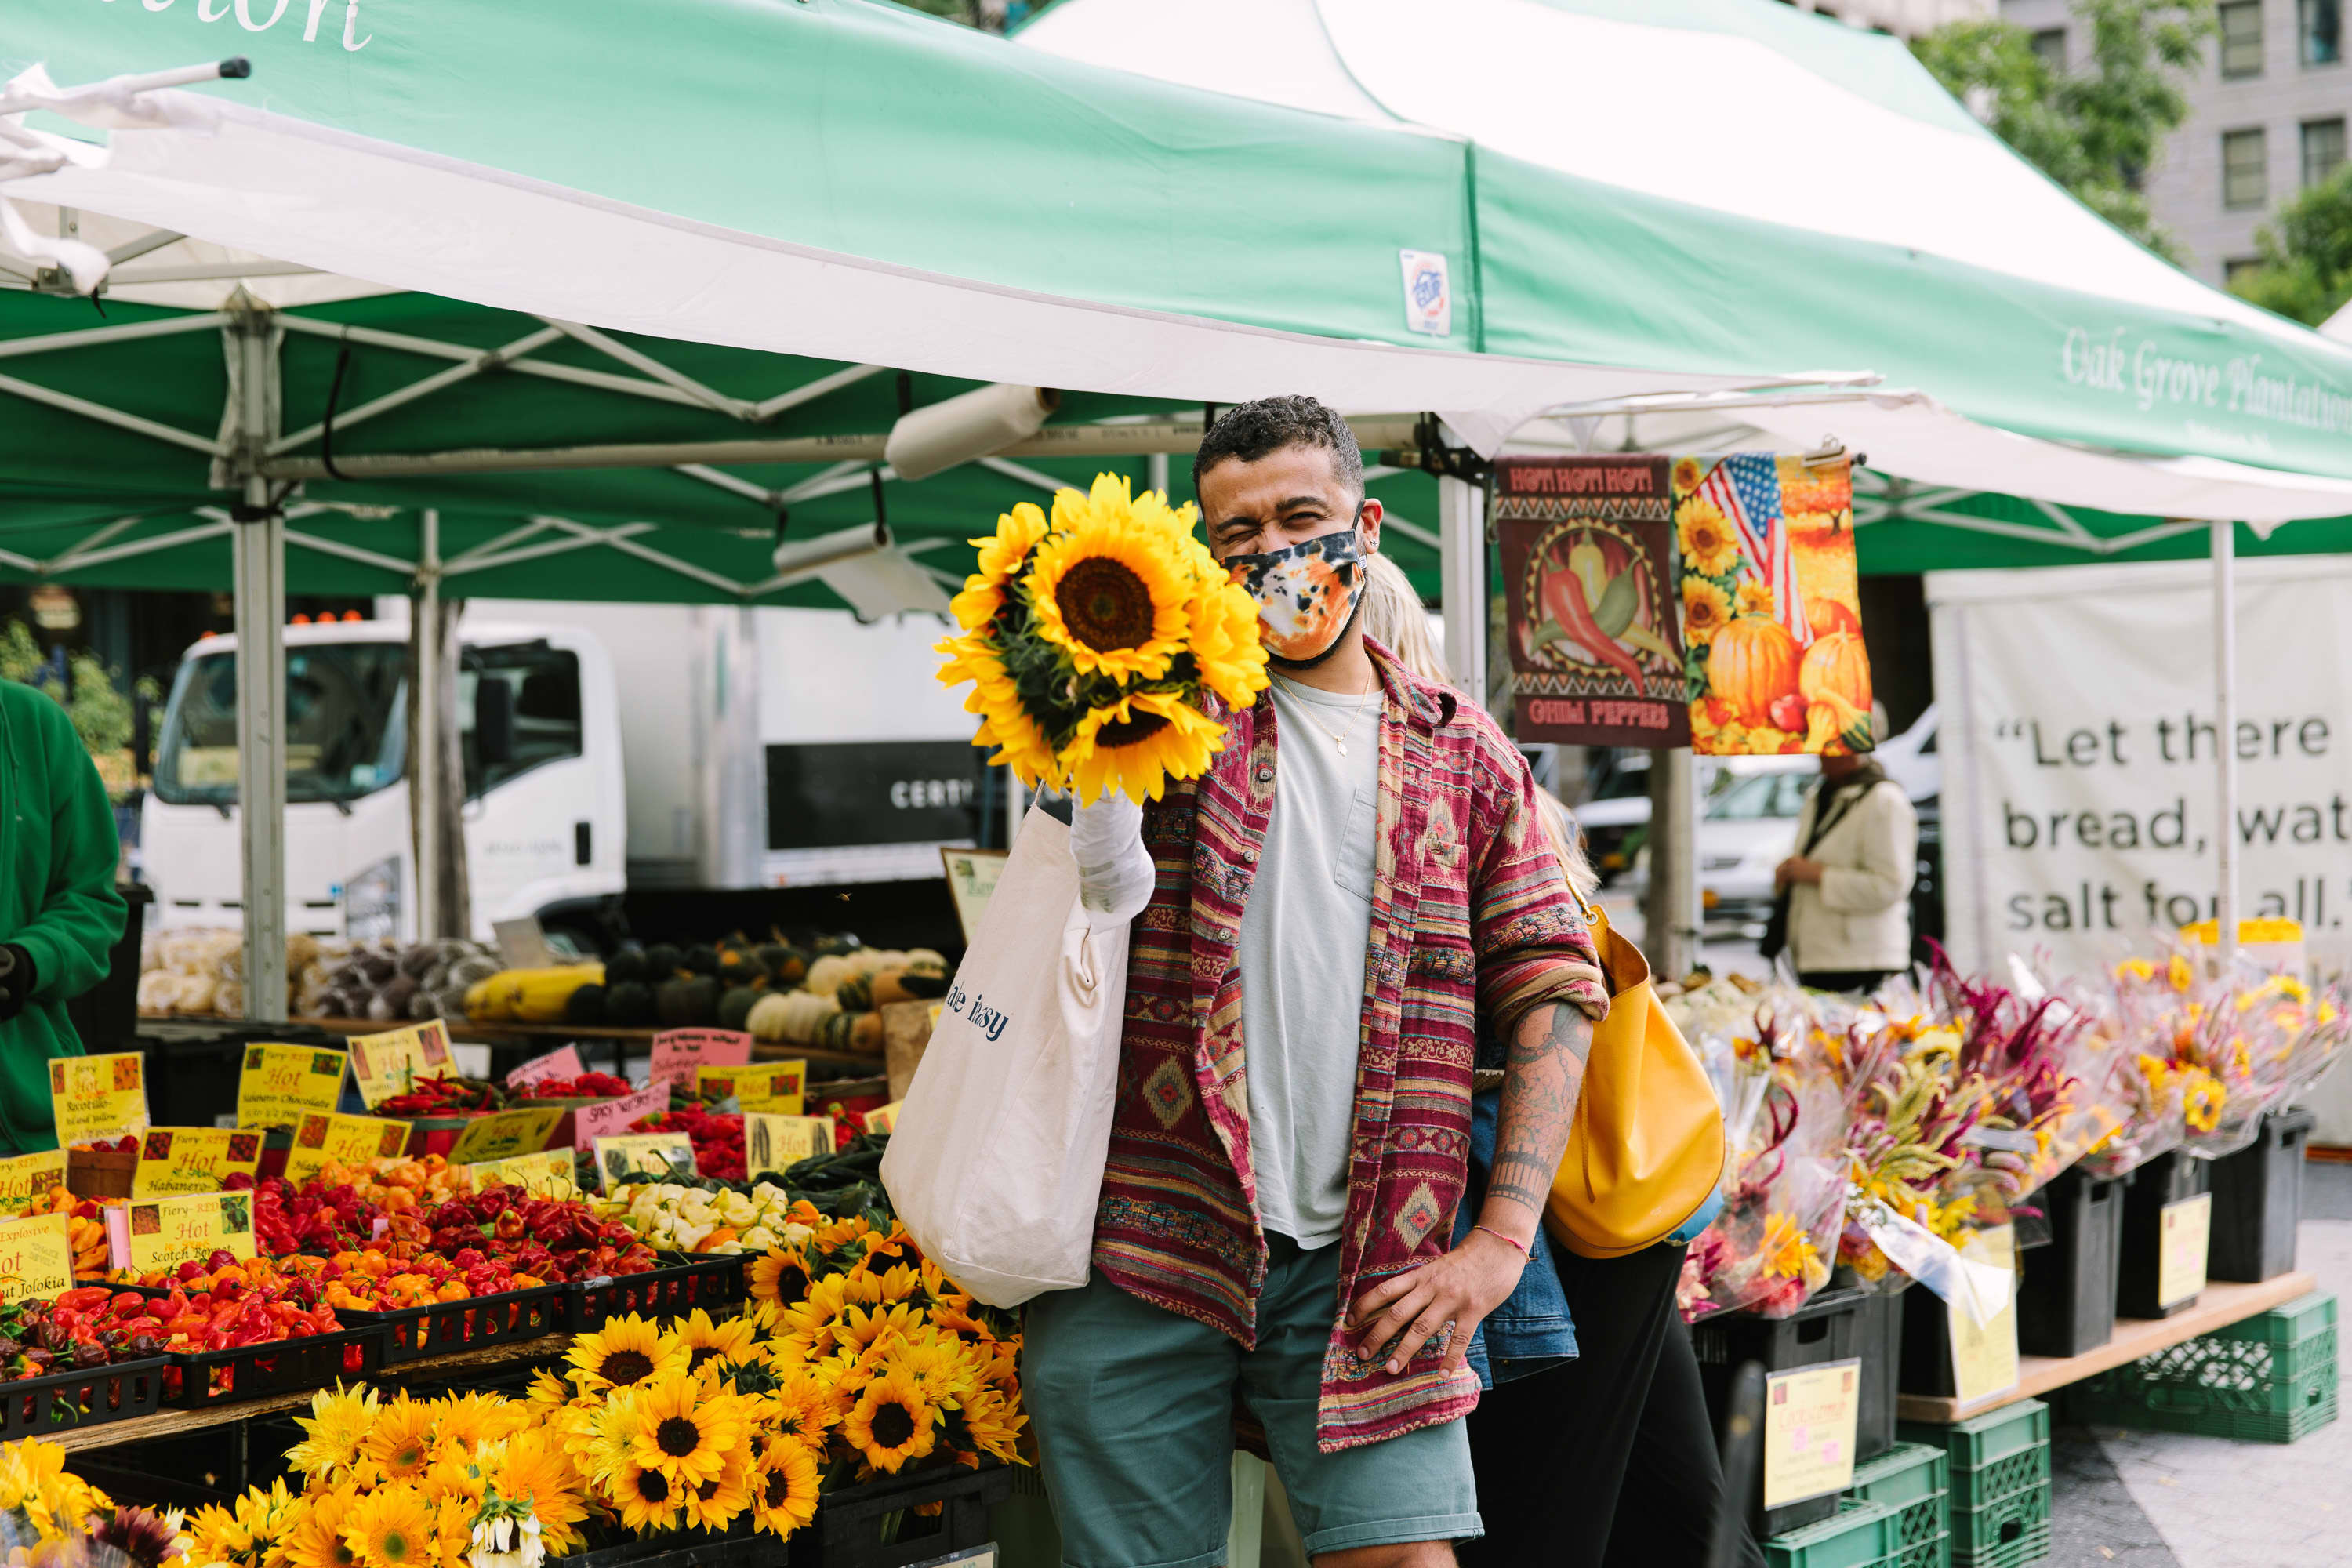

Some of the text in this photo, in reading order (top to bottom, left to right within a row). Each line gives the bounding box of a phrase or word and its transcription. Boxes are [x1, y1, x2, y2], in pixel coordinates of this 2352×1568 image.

[2063, 325, 2127, 391] Oak
[2134, 340, 2220, 411] Grove
[1590, 700, 1669, 730] PEPPERS
[2157, 712, 2329, 764] there
[2004, 797, 2206, 853] bread,
[2009, 881, 2120, 931] salt
[263, 1065, 303, 1087] Hot
[329, 1137, 374, 1158] Hot
[173, 1149, 220, 1172] Hot
[196, 1201, 220, 1214] RED
[175, 1219, 212, 1240] Hot
[0, 1250, 24, 1275] ot
[151, 1250, 189, 1264] Scotch
[18, 1275, 65, 1298] Jolokia
